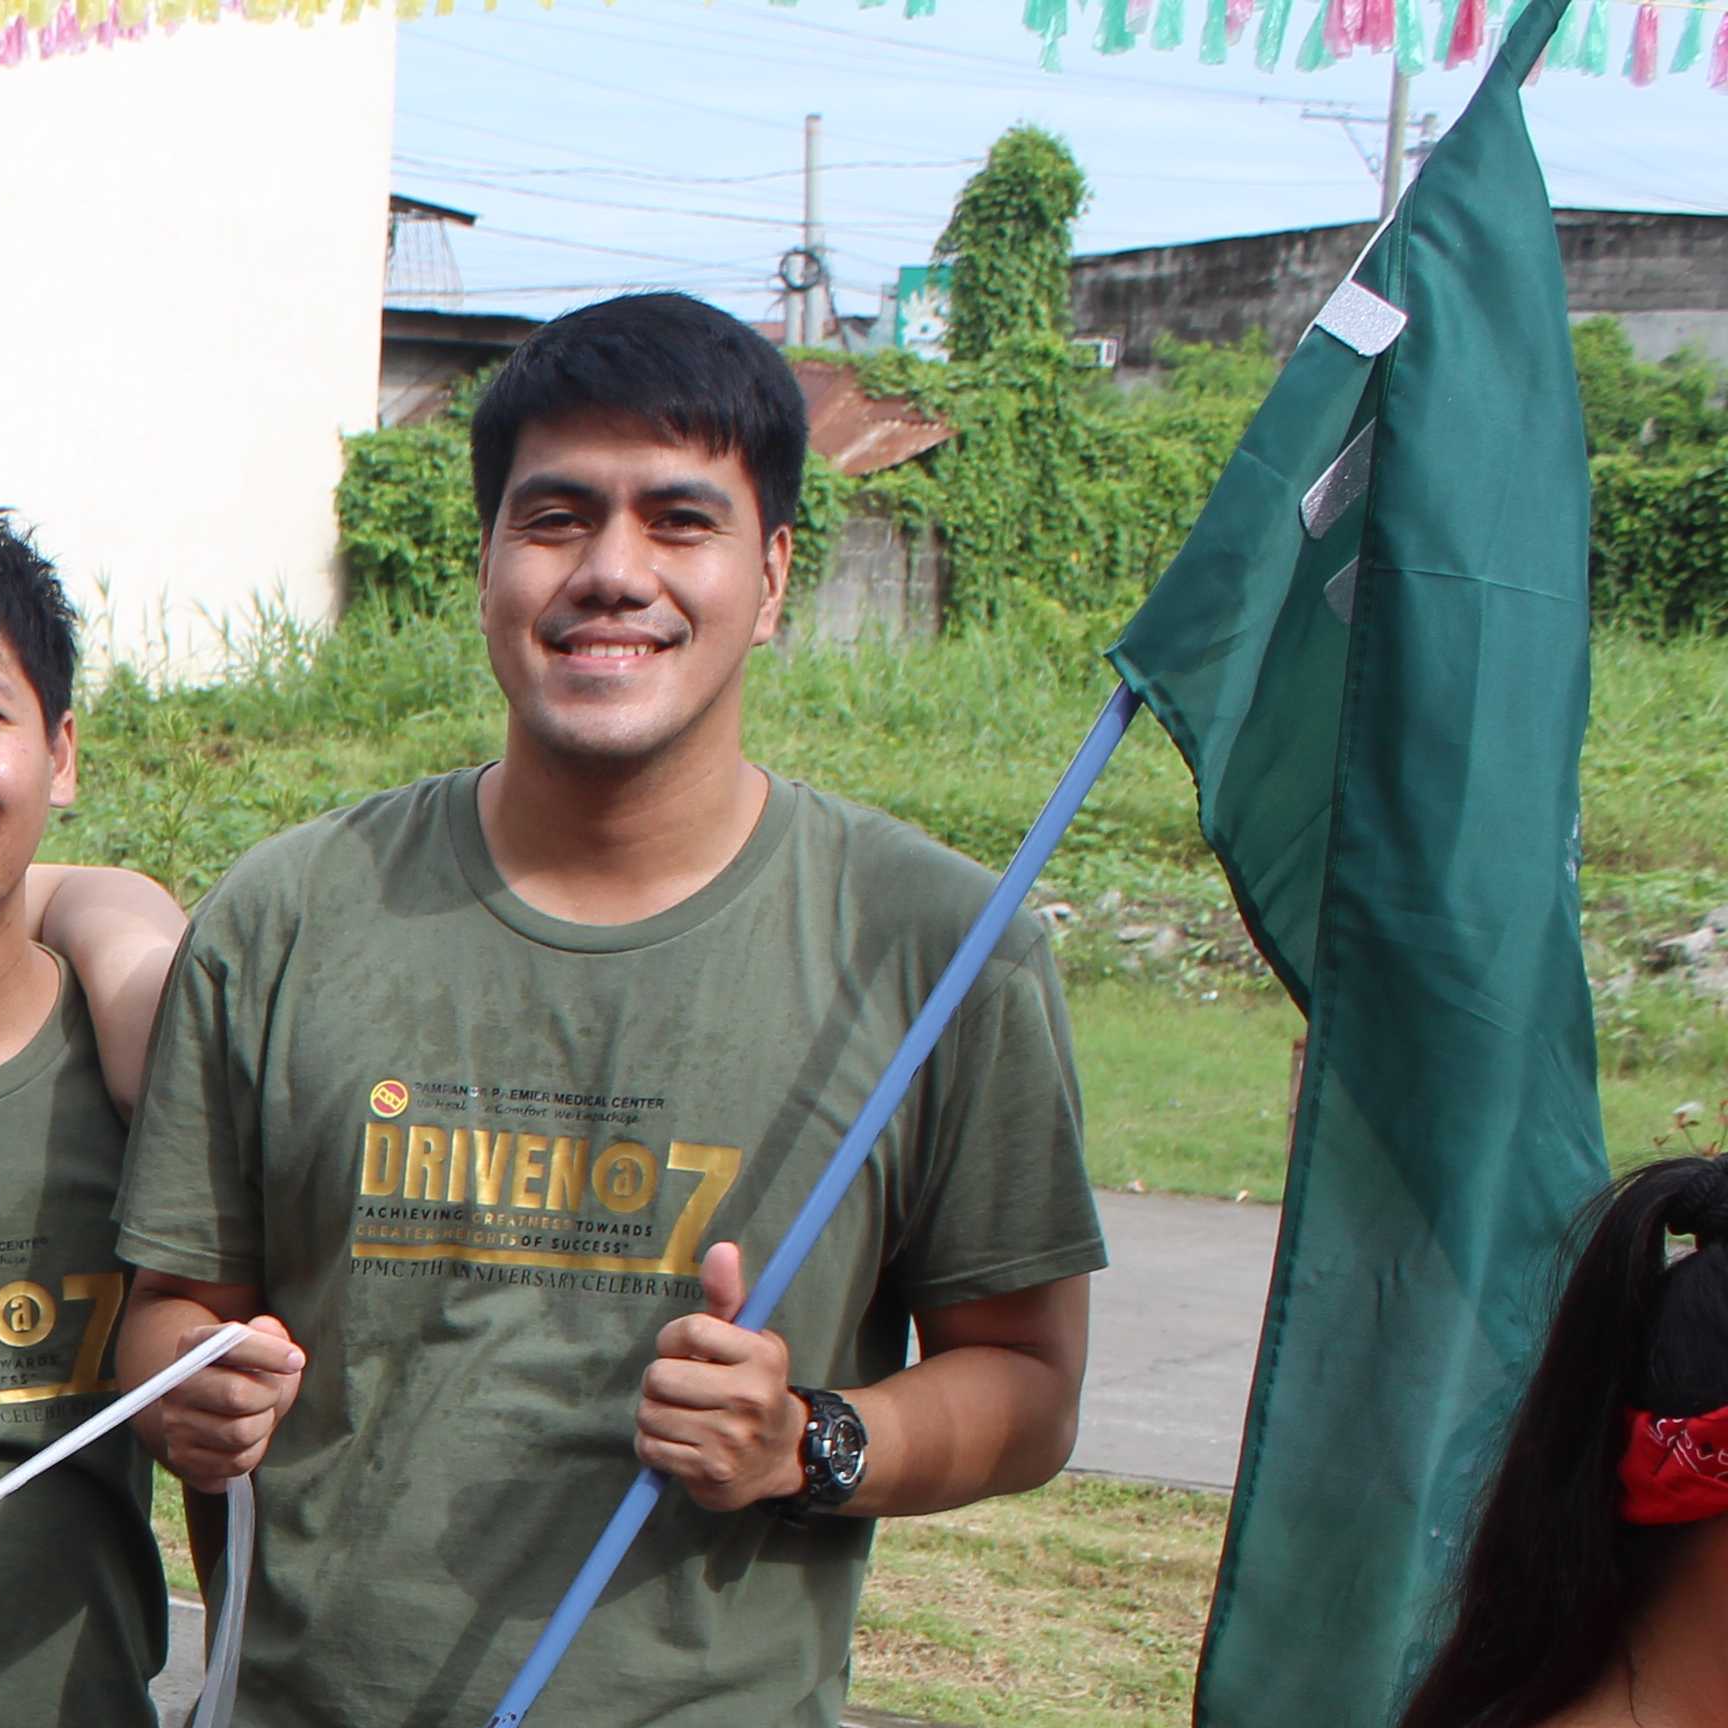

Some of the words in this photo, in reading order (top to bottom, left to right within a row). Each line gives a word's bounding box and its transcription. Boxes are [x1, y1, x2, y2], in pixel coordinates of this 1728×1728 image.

[494, 1102, 547, 1118] Comfort
[553, 1092, 607, 1108] MEDICAL
[611, 1096, 665, 1111] CENTER
[355, 1223, 434, 1241] GREATER
[442, 1228, 518, 1247] HEIGHTS
[521, 1235, 543, 1248] OF
[471, 1211, 574, 1231] GREATNESS
[575, 1219, 654, 1239] TOWARDS
[350, 1258, 404, 1278] PPMC
[409, 1259, 444, 1278] 7TH
[446, 1260, 578, 1289] ANNIVERSARY
[581, 1275, 705, 1300] CELEBRATIO
